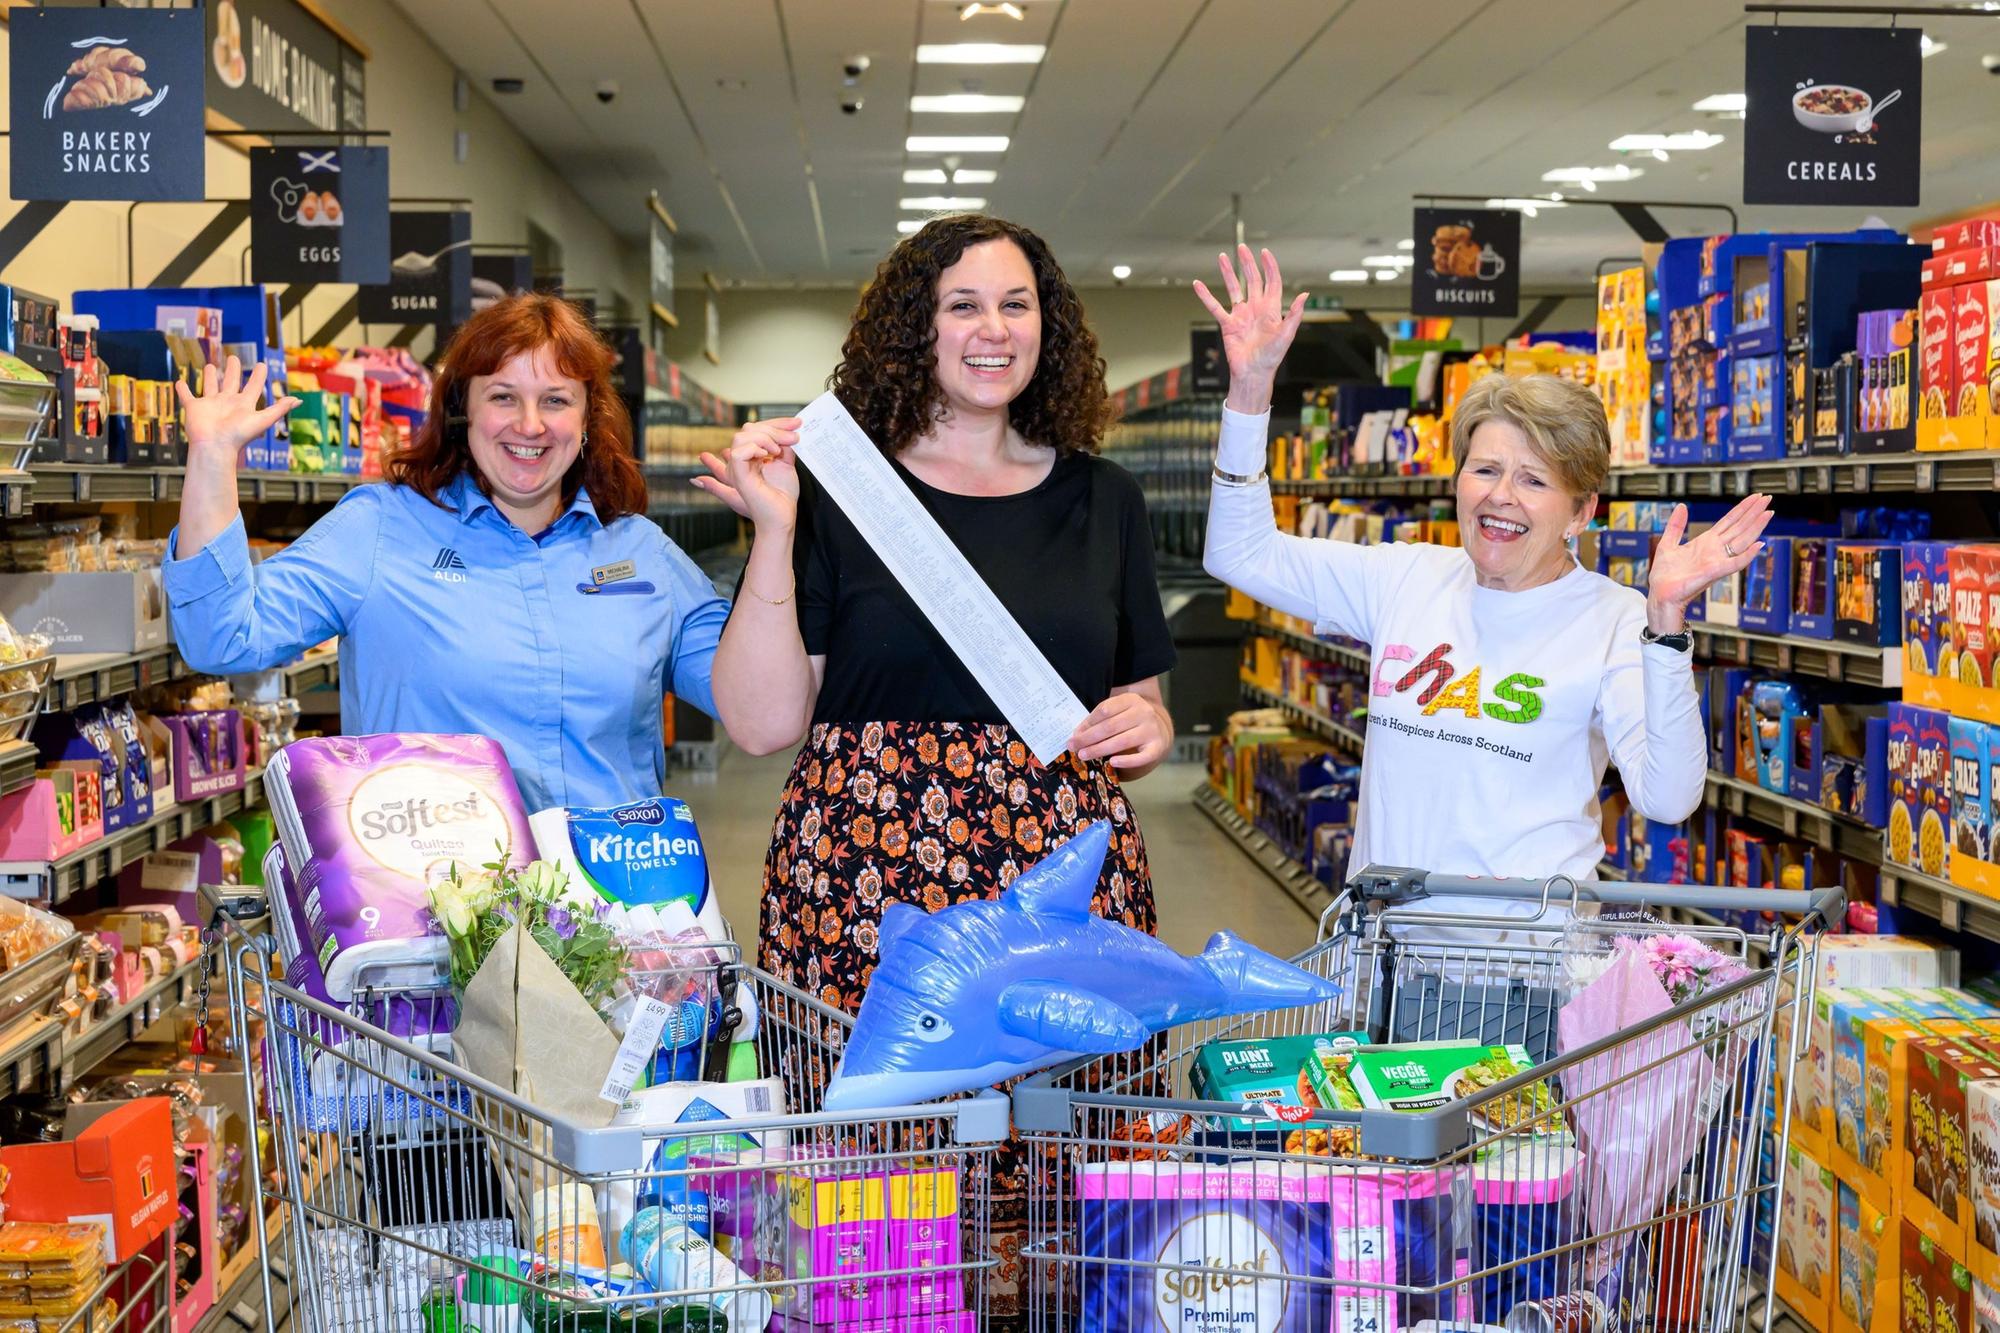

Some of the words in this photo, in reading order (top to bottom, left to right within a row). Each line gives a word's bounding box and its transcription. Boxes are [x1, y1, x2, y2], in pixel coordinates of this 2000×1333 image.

[63, 132, 151, 150] BAKERY
[64, 153, 150, 172] SNACKS
[1788, 162, 1876, 181] CEREALS
[300, 247, 341, 262] EGGS
[392, 296, 437, 309] SUGAR
[1436, 289, 1495, 303] BISCUITS
[434, 571, 466, 583] ALDI
[1955, 589, 1982, 626] CRAZE
[1389, 717, 1434, 738] Hospices
[1436, 729, 1473, 745] Across
[1475, 737, 1533, 763] Scotland
[1954, 757, 1979, 797] CRAZE
[361, 791, 487, 839] Softest
[590, 832, 700, 863] Kitchen
[625, 857, 677, 871] TOWELS
[360, 907, 381, 929] 9
[646, 1002, 666, 1016] £4.99
[1222, 1048, 1271, 1066] PLANT
[1380, 1064, 1429, 1079] VEGGIE
[1245, 1090, 1281, 1099] ULTIMATE
[1419, 1099, 1447, 1107] PROTEIN
[1206, 1177, 1236, 1187] SAME
[1184, 1308, 1255, 1322] Premium
[1353, 1317, 1378, 1332] 24
